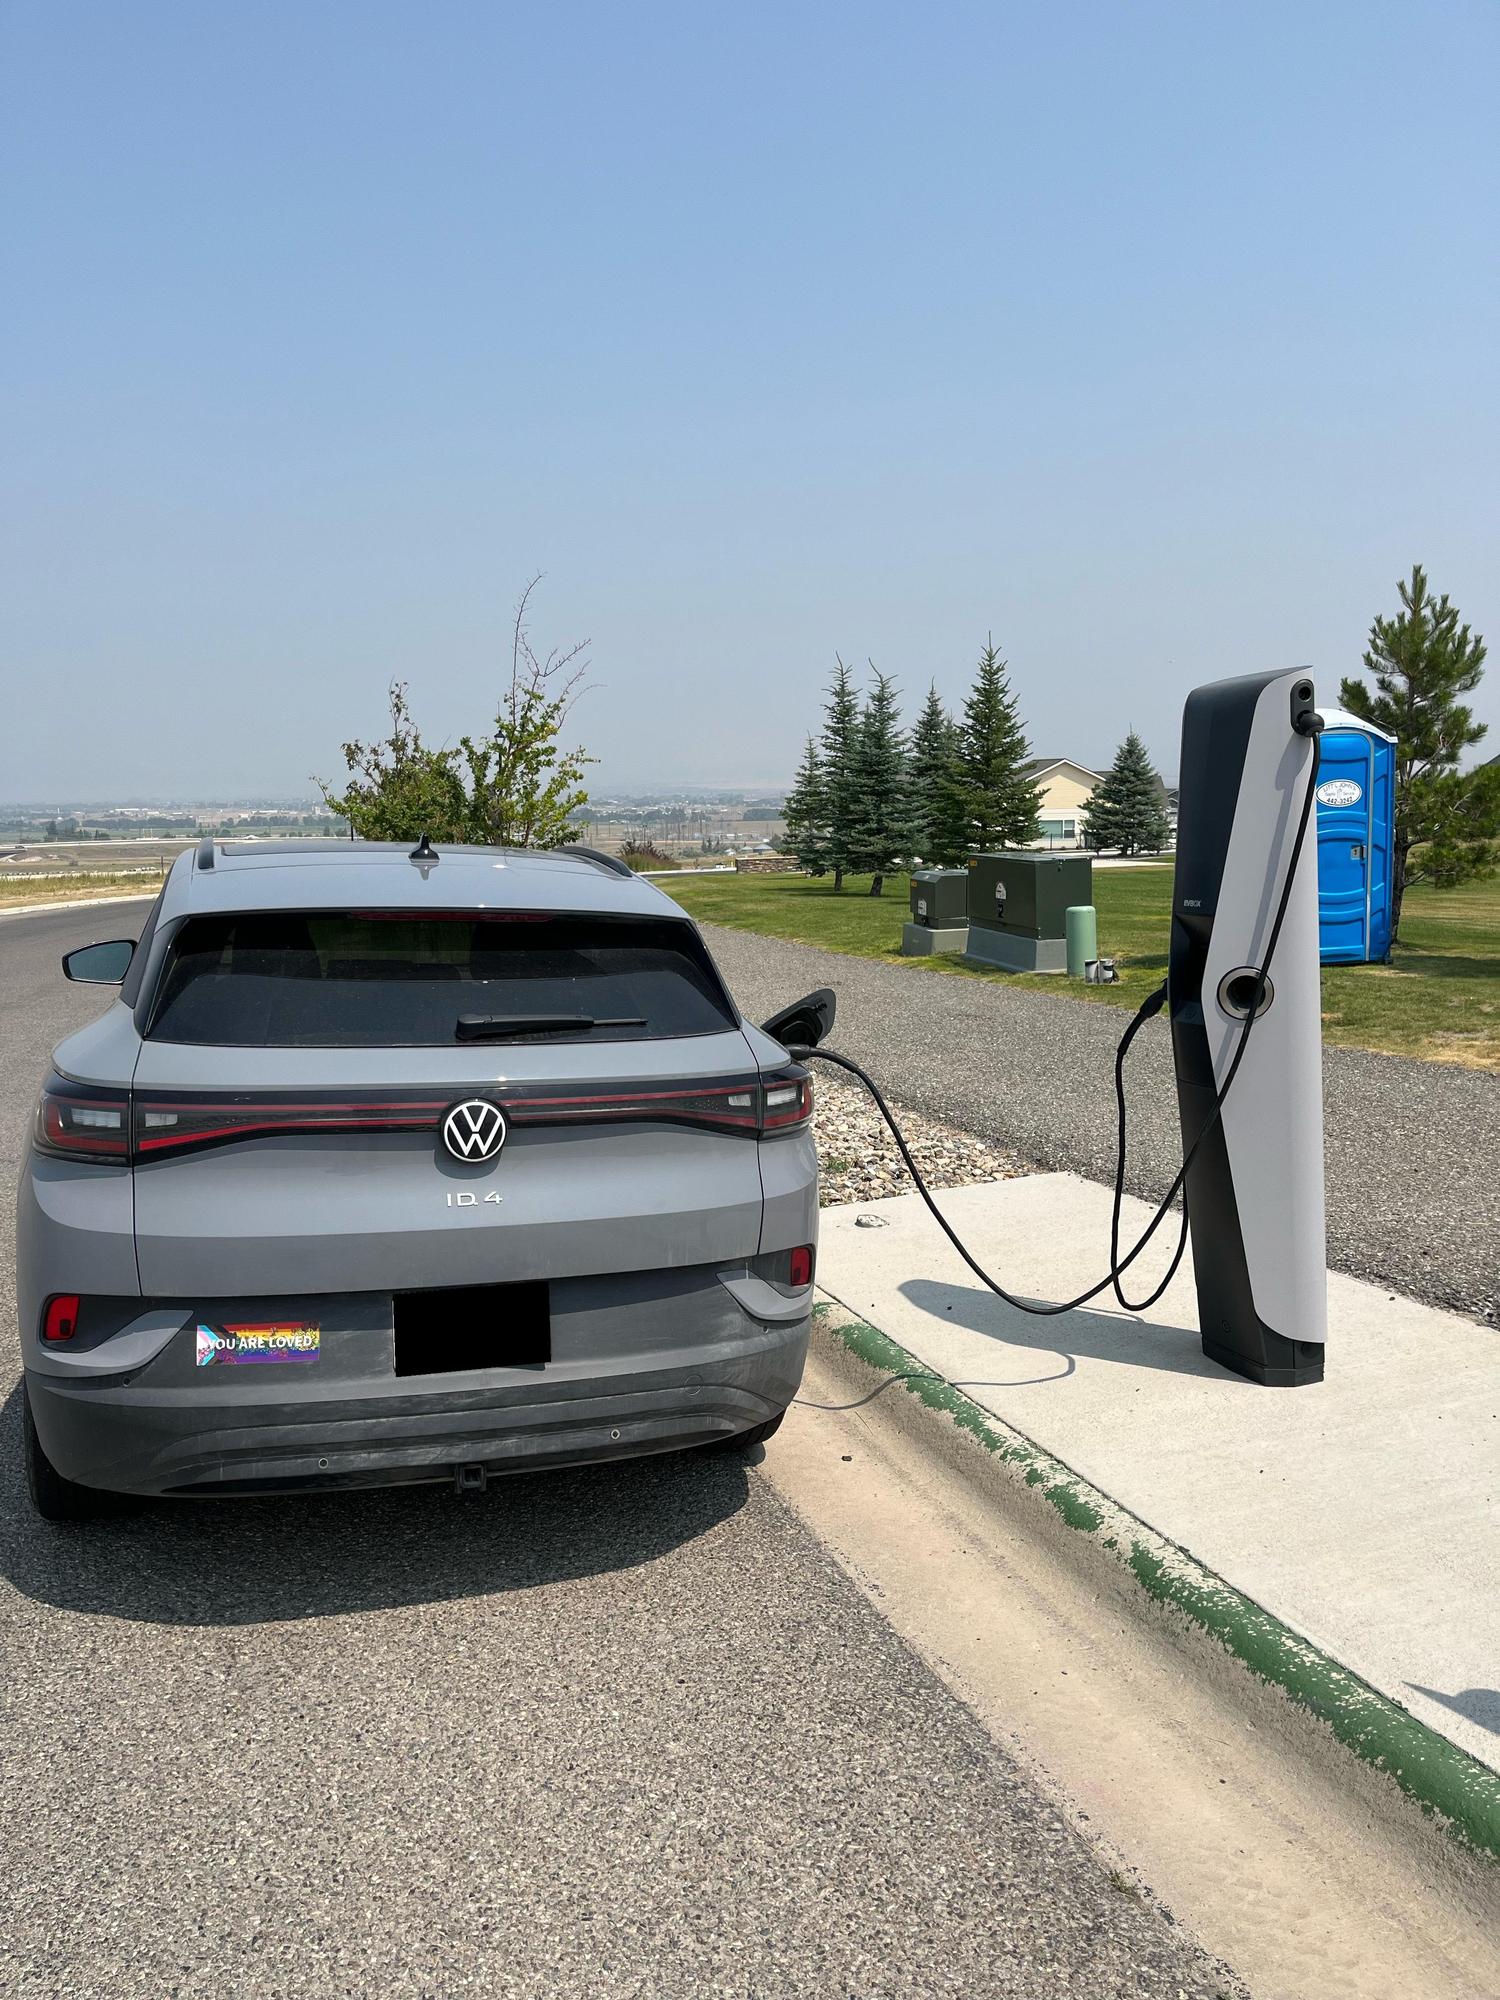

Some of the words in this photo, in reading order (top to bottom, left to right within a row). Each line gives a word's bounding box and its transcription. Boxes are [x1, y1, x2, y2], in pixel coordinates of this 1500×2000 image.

[444, 1102, 506, 1162] VW
[238, 1336, 266, 1349] ARE
[268, 1334, 313, 1348] LOVED
